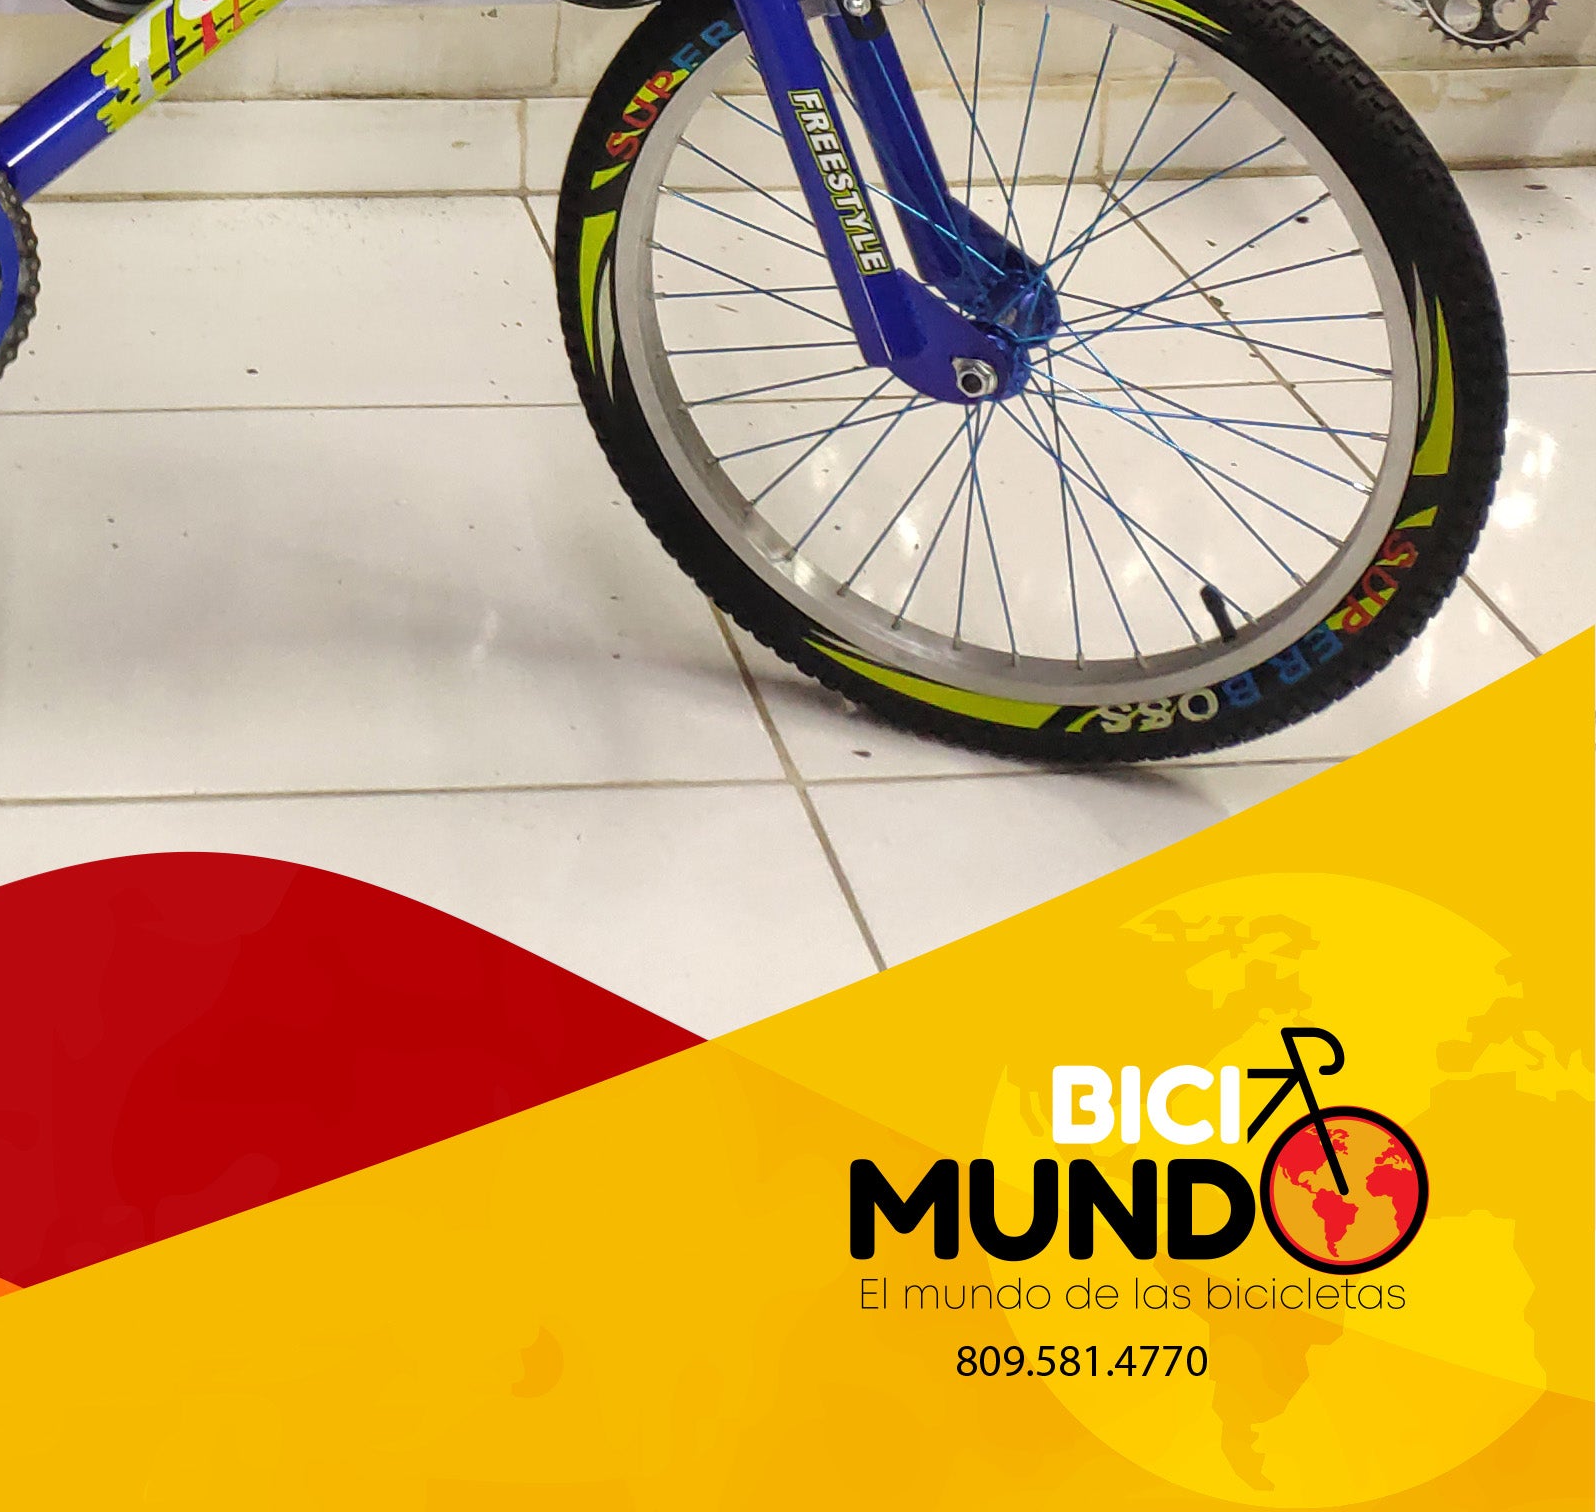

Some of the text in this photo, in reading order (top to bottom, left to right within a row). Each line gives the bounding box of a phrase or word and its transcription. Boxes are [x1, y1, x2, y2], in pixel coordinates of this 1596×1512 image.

[606, 19, 737, 160] SUPER
[791, 90, 890, 274] FREESTYLE
[1266, 530, 1419, 685] SUPER
